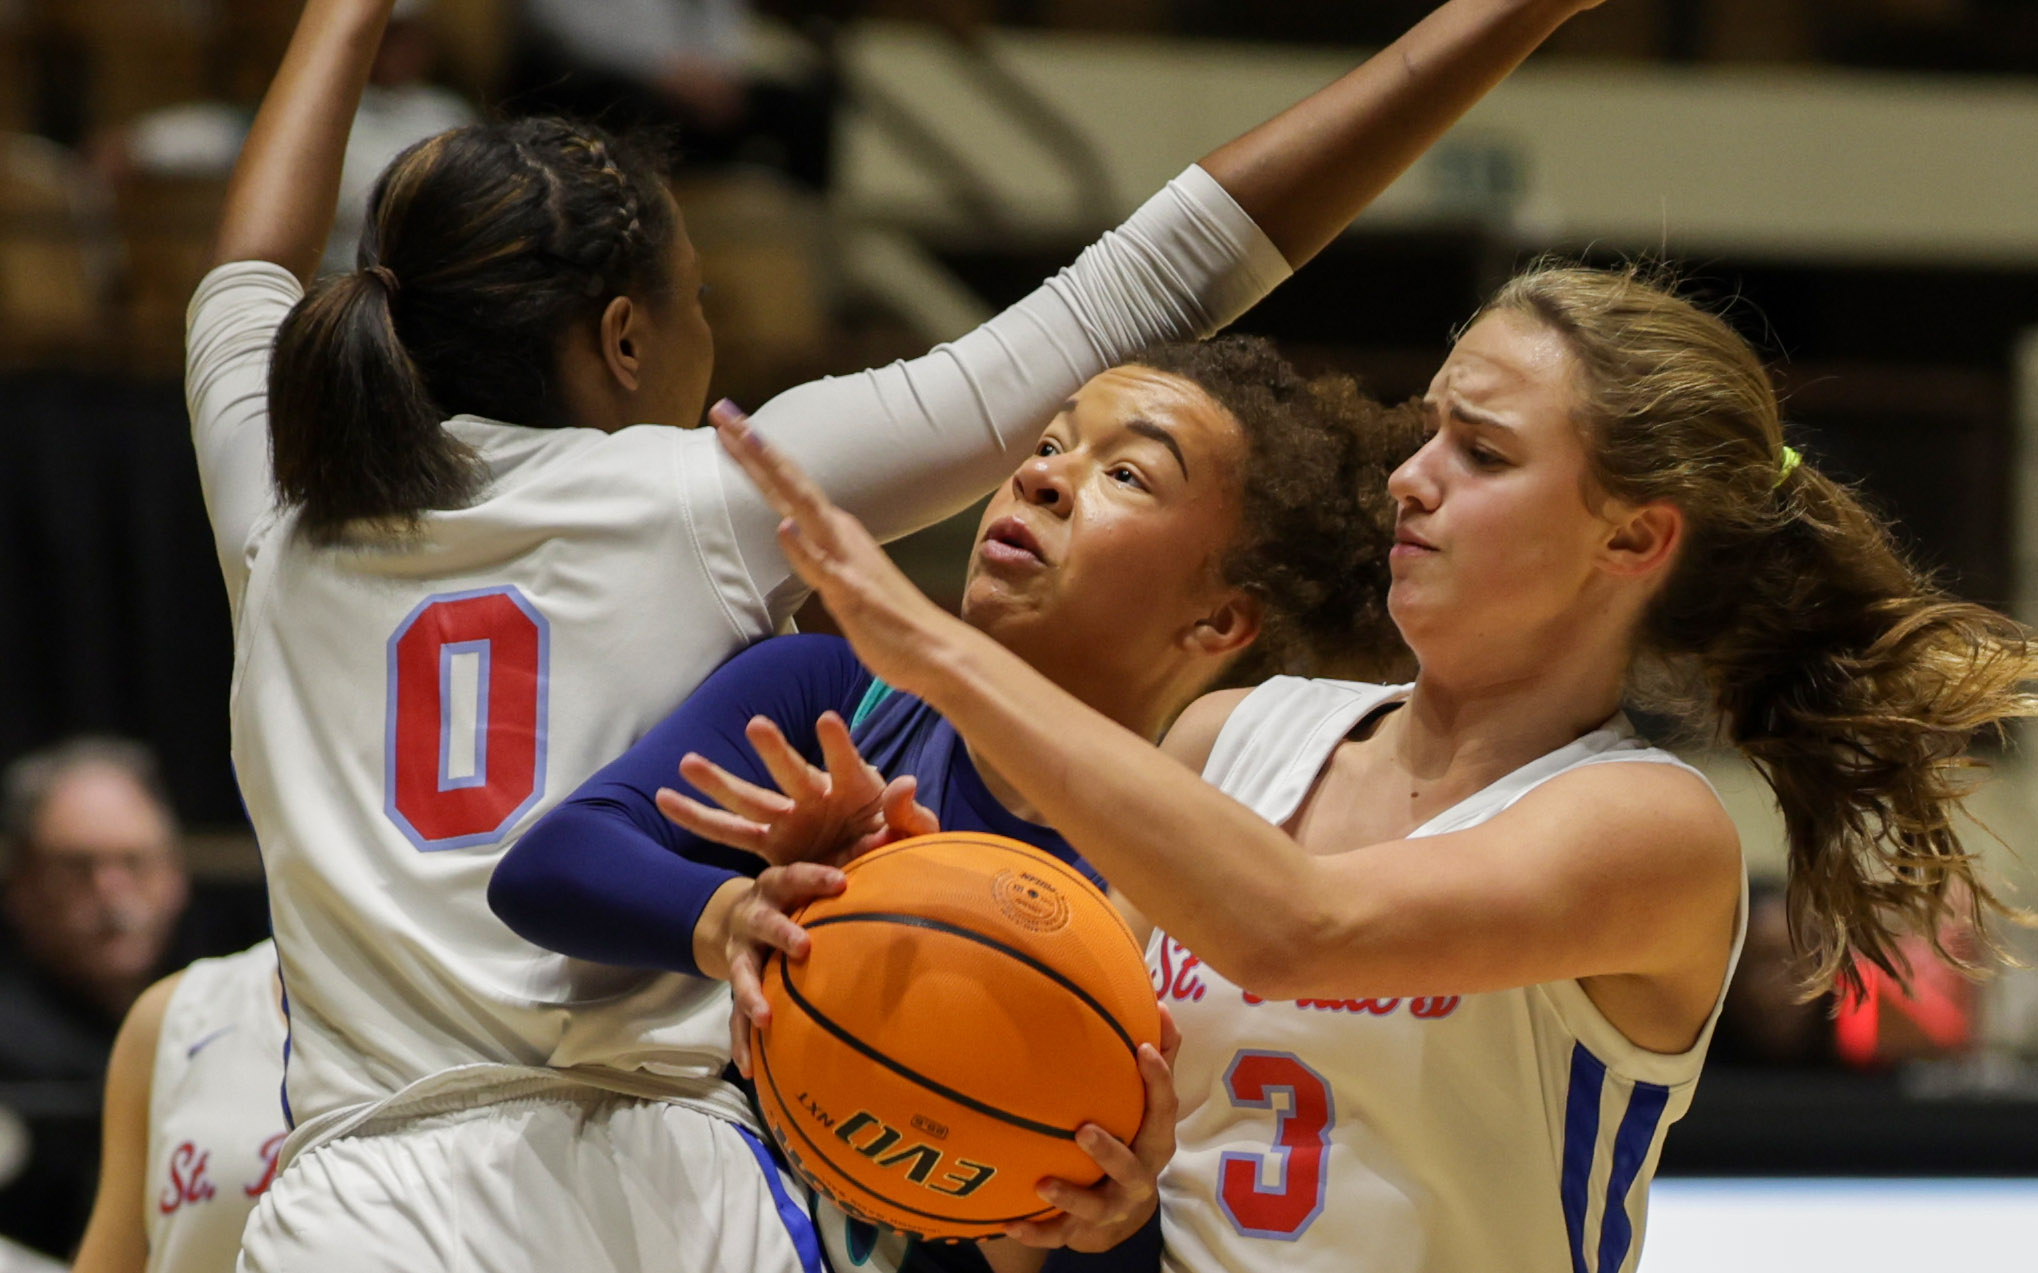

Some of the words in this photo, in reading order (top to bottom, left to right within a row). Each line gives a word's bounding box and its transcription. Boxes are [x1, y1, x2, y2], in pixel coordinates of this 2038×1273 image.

[383, 584, 549, 853] 0
[796, 1091, 836, 1129] NXT
[833, 1109, 998, 1199] EVO
[1216, 1048, 1336, 1242] 3
[158, 1139, 217, 1215] St.
